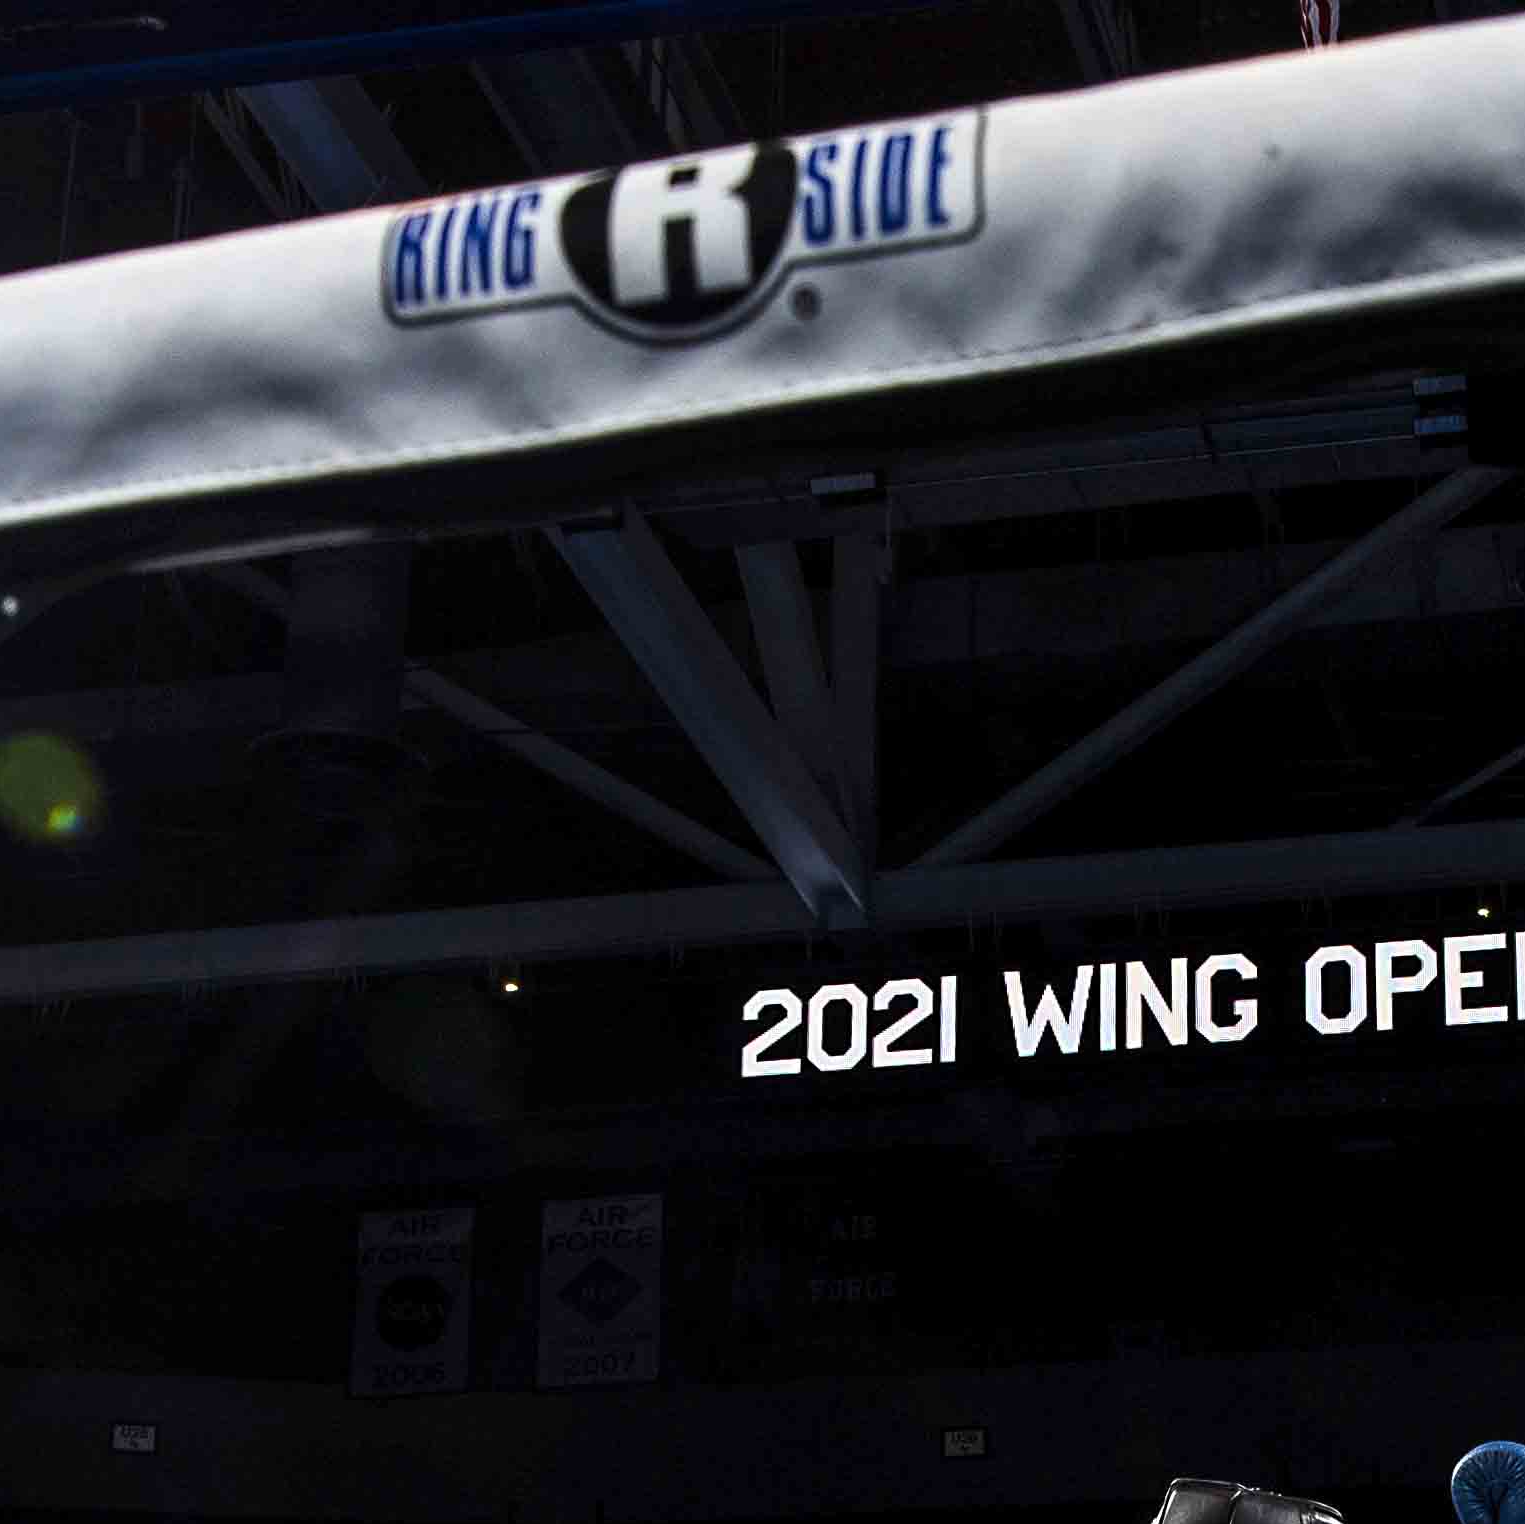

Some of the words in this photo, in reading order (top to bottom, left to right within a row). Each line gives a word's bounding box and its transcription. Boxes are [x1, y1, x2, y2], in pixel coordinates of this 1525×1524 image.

[394, 189, 542, 306] RING
[801, 123, 955, 246] SIDE
[741, 975, 958, 1077] 2021
[1004, 952, 1258, 1057] WING
[547, 1227, 656, 1256] FORCE
[578, 1205, 630, 1229] AIR
